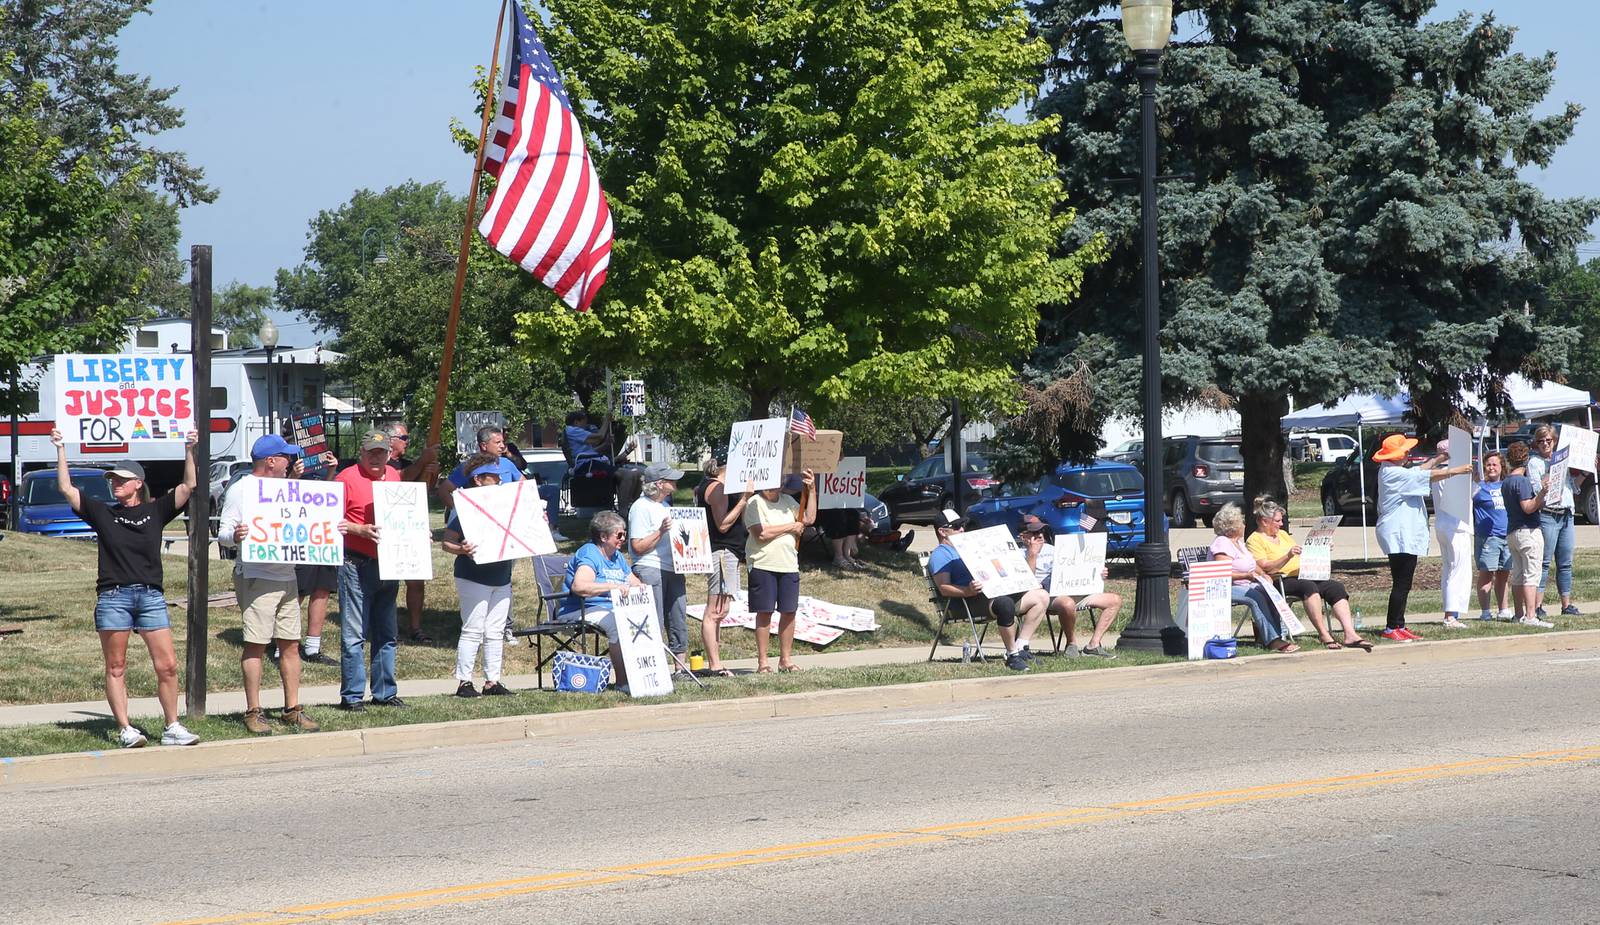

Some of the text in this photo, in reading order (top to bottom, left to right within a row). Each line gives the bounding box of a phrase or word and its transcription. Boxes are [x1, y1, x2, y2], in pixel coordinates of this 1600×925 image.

[66, 358, 185, 382] LIBERTY
[119, 380, 135, 390] and
[65, 388, 191, 419] JUSTICE
[79, 418, 184, 441] FOR ALL
[751, 424, 763, 438] NO
[742, 440, 778, 458] CROWNS
[746, 458, 757, 468] FOR
[280, 506, 307, 518] IS A
[670, 509, 704, 520] DEMOCRACY
[250, 516, 334, 545] STOOGE
[249, 543, 340, 563] FOR THE RICH
[618, 592, 650, 607] NO KINGS
[636, 655, 657, 669] SINCE
[642, 672, 659, 689] 1776
